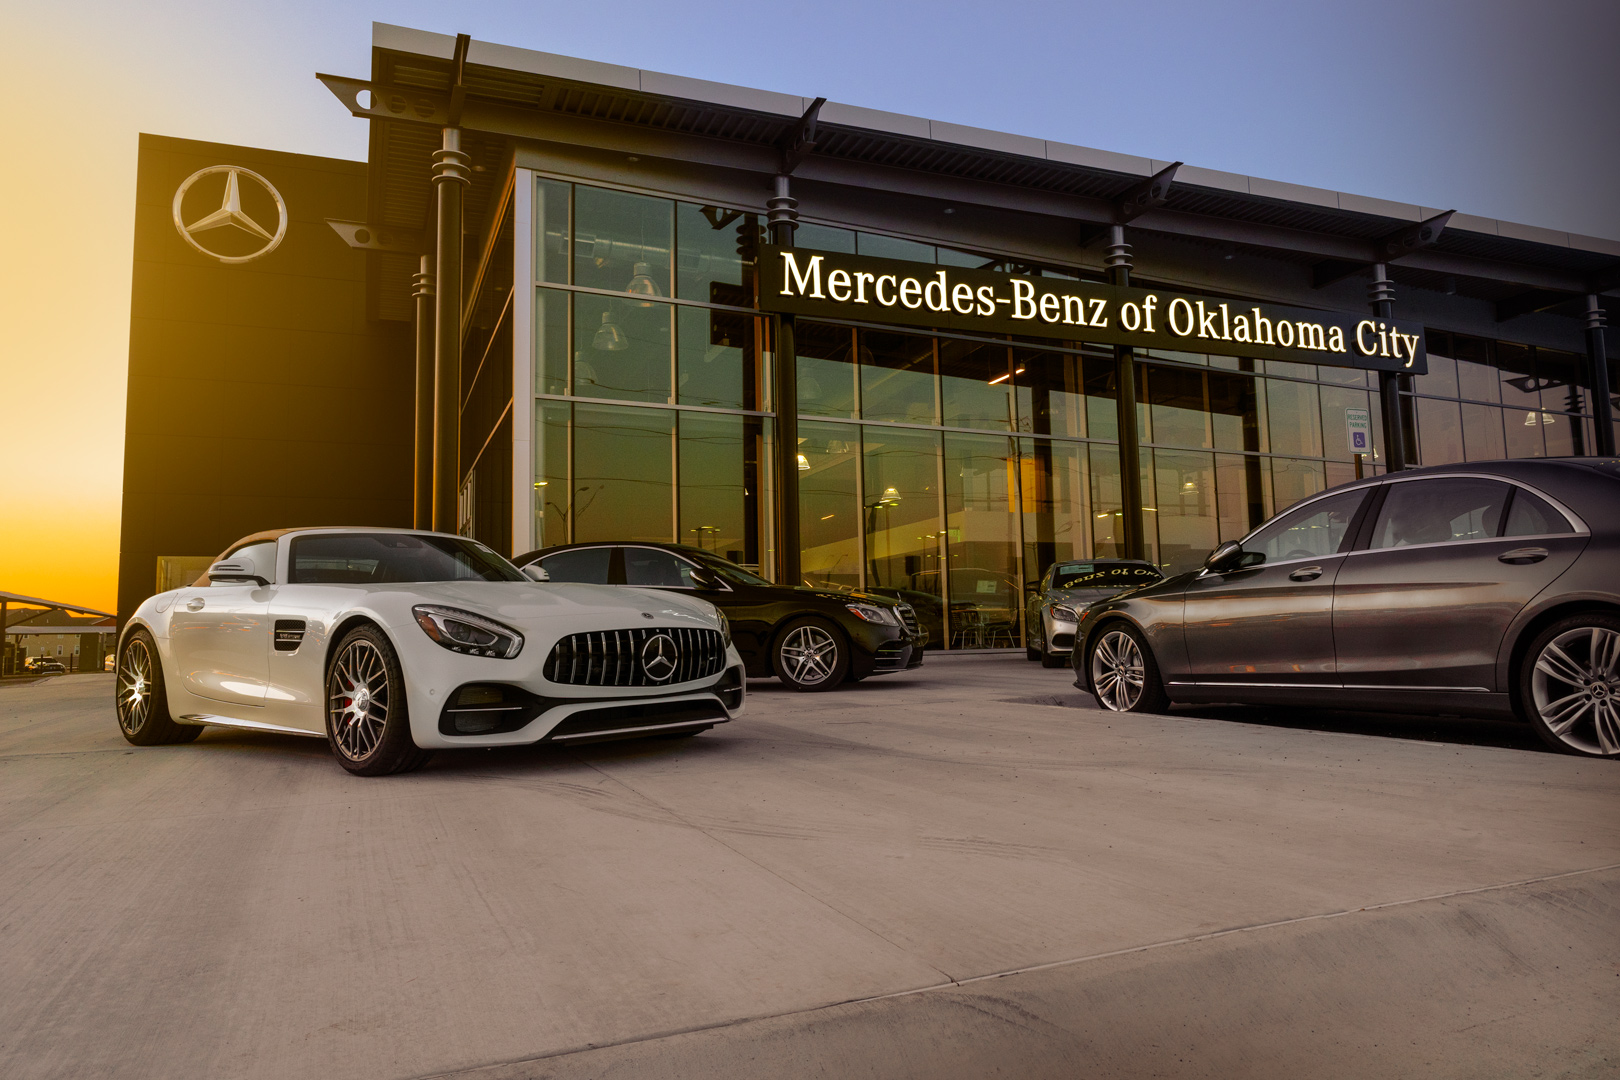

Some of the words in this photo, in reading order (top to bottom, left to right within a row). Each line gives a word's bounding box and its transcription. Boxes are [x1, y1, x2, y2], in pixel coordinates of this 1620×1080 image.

[779, 251, 1108, 328] Mercedes-Benz
[1120, 294, 1158, 333] of
[1168, 297, 1347, 354] Oklahoma
[1356, 319, 1419, 368] City
